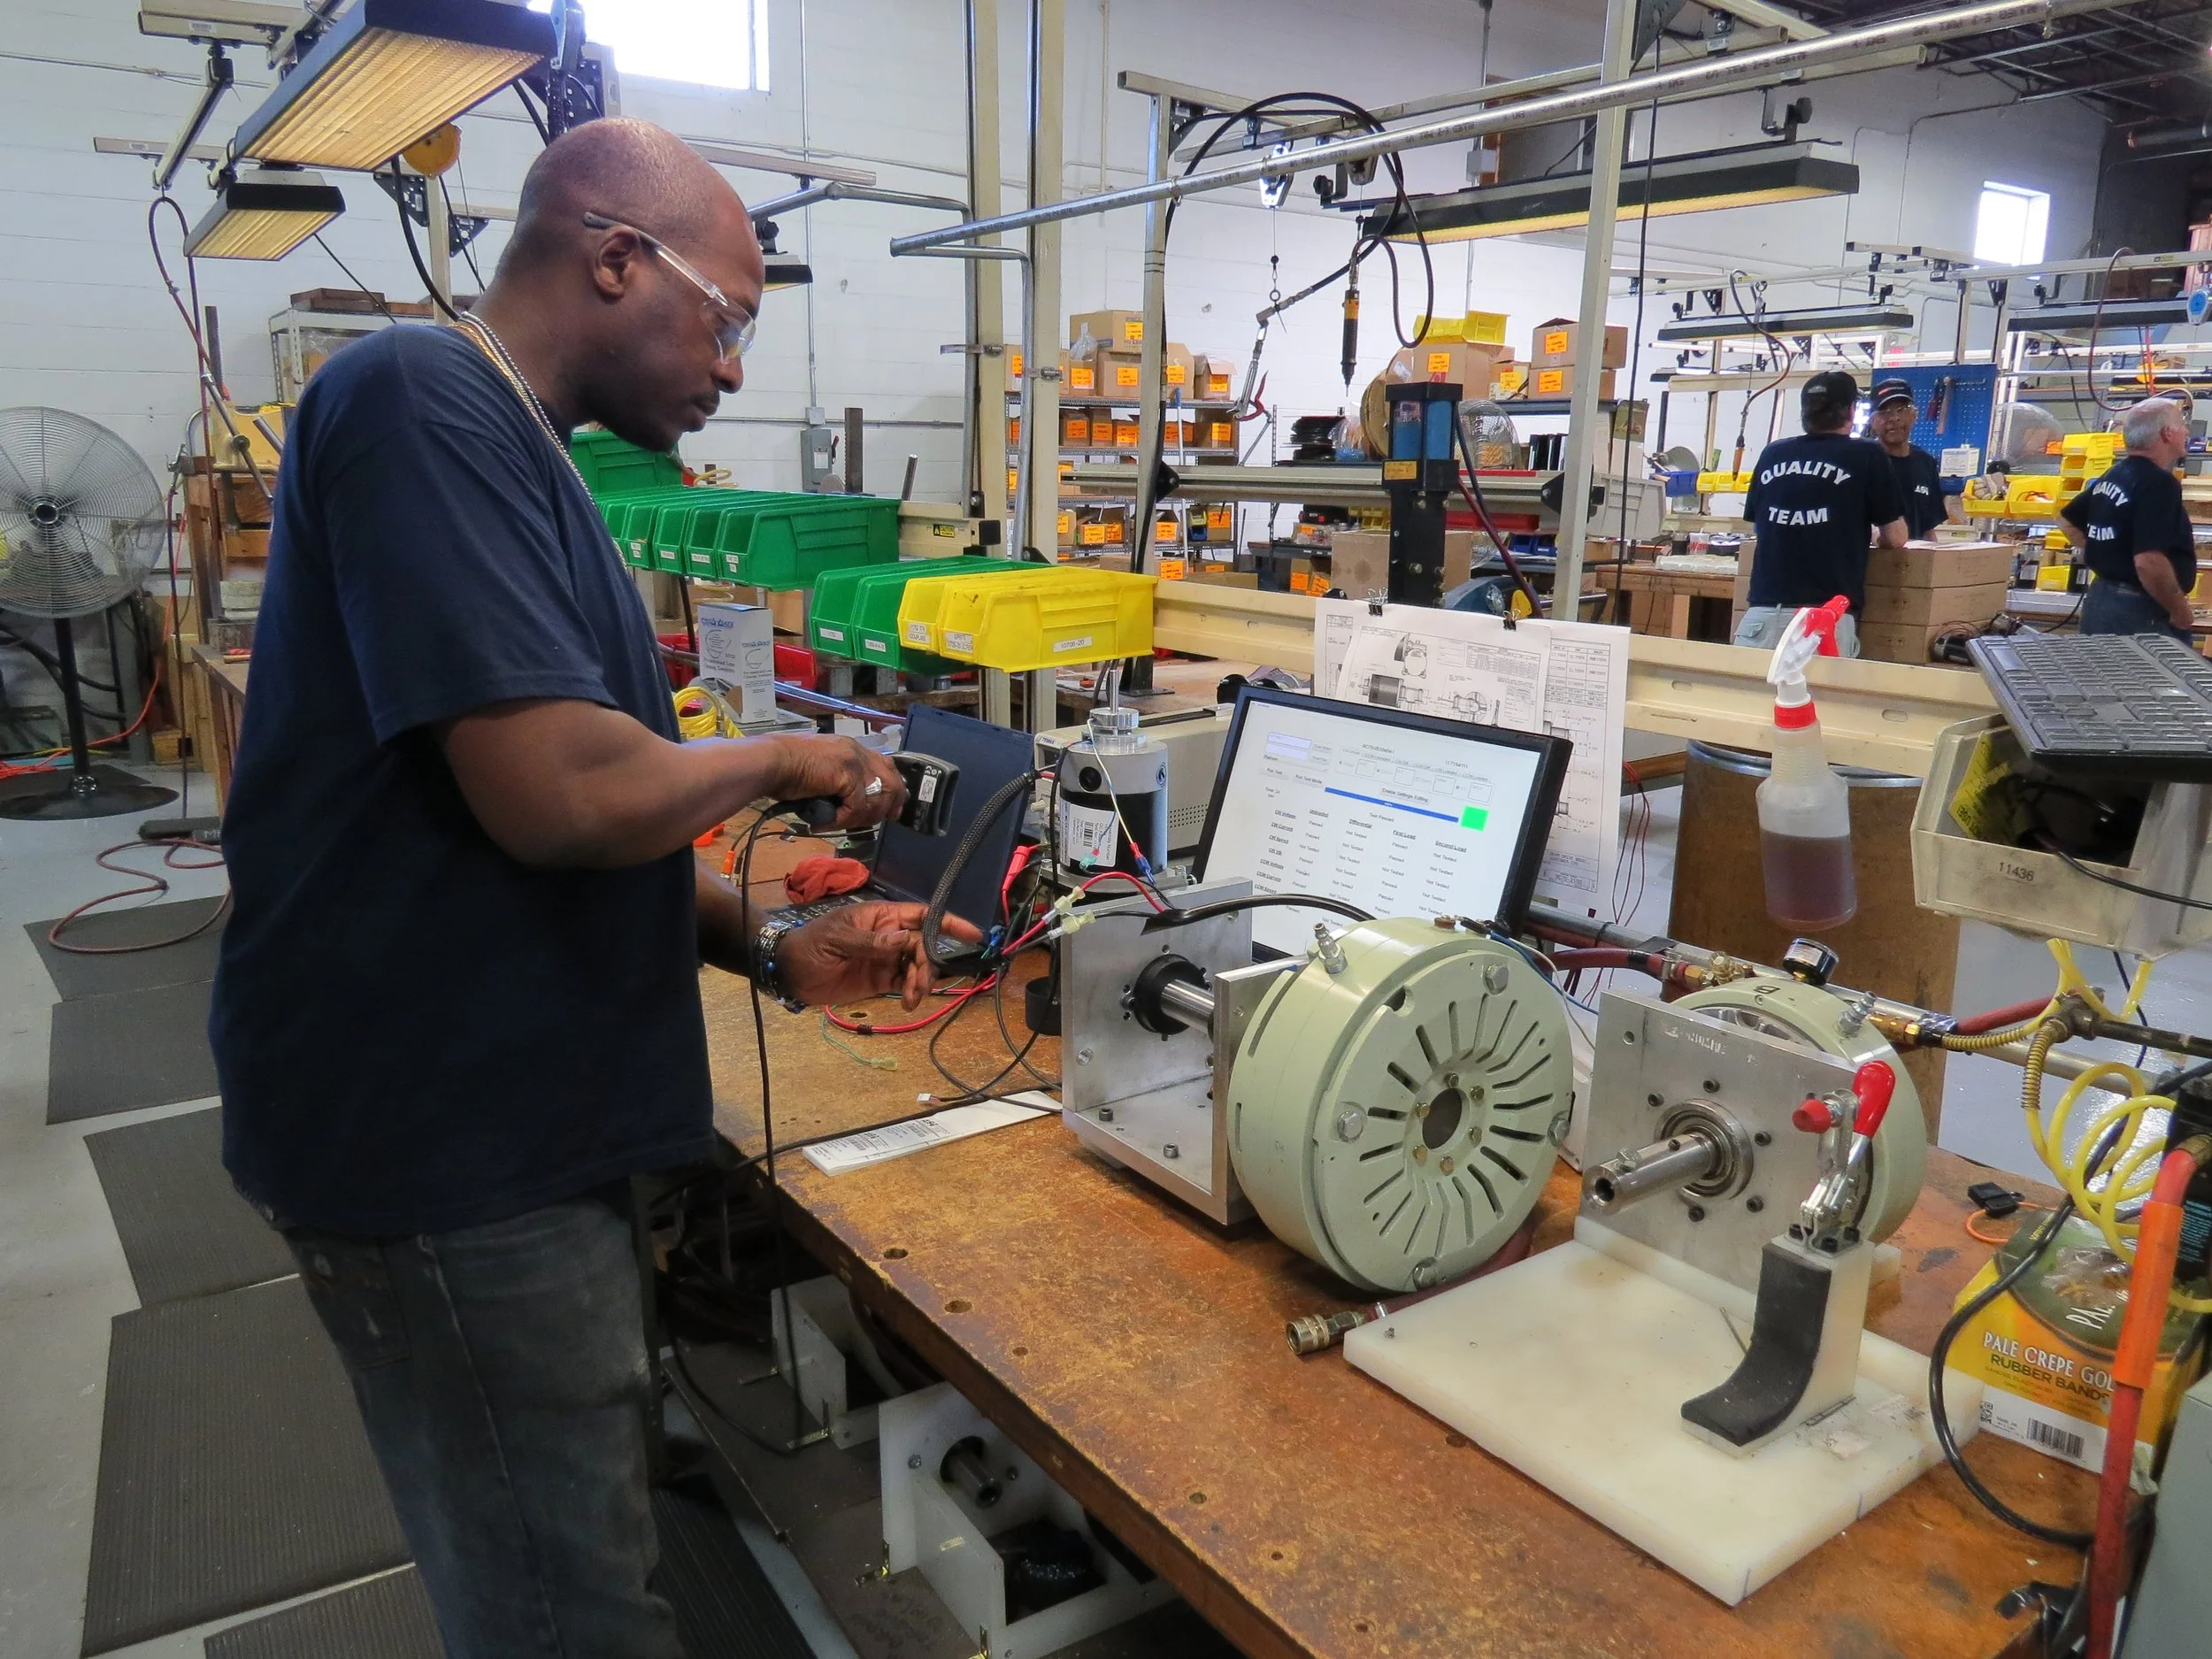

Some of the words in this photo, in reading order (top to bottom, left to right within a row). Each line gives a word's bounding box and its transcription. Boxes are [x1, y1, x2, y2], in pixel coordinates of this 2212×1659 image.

[1760, 460, 1851, 486] QUALITY
[2093, 480, 2129, 507] UALITY
[1769, 506, 1828, 526] TEAM
[2087, 523, 2115, 541] EAM
[1998, 862, 2034, 881] 11436
[1983, 1331, 2018, 1358] PALE
[2024, 1347, 2074, 1378] CREPE
[2081, 1366, 2115, 1392] GOL
[1991, 1354, 2051, 1382] RUBBER
